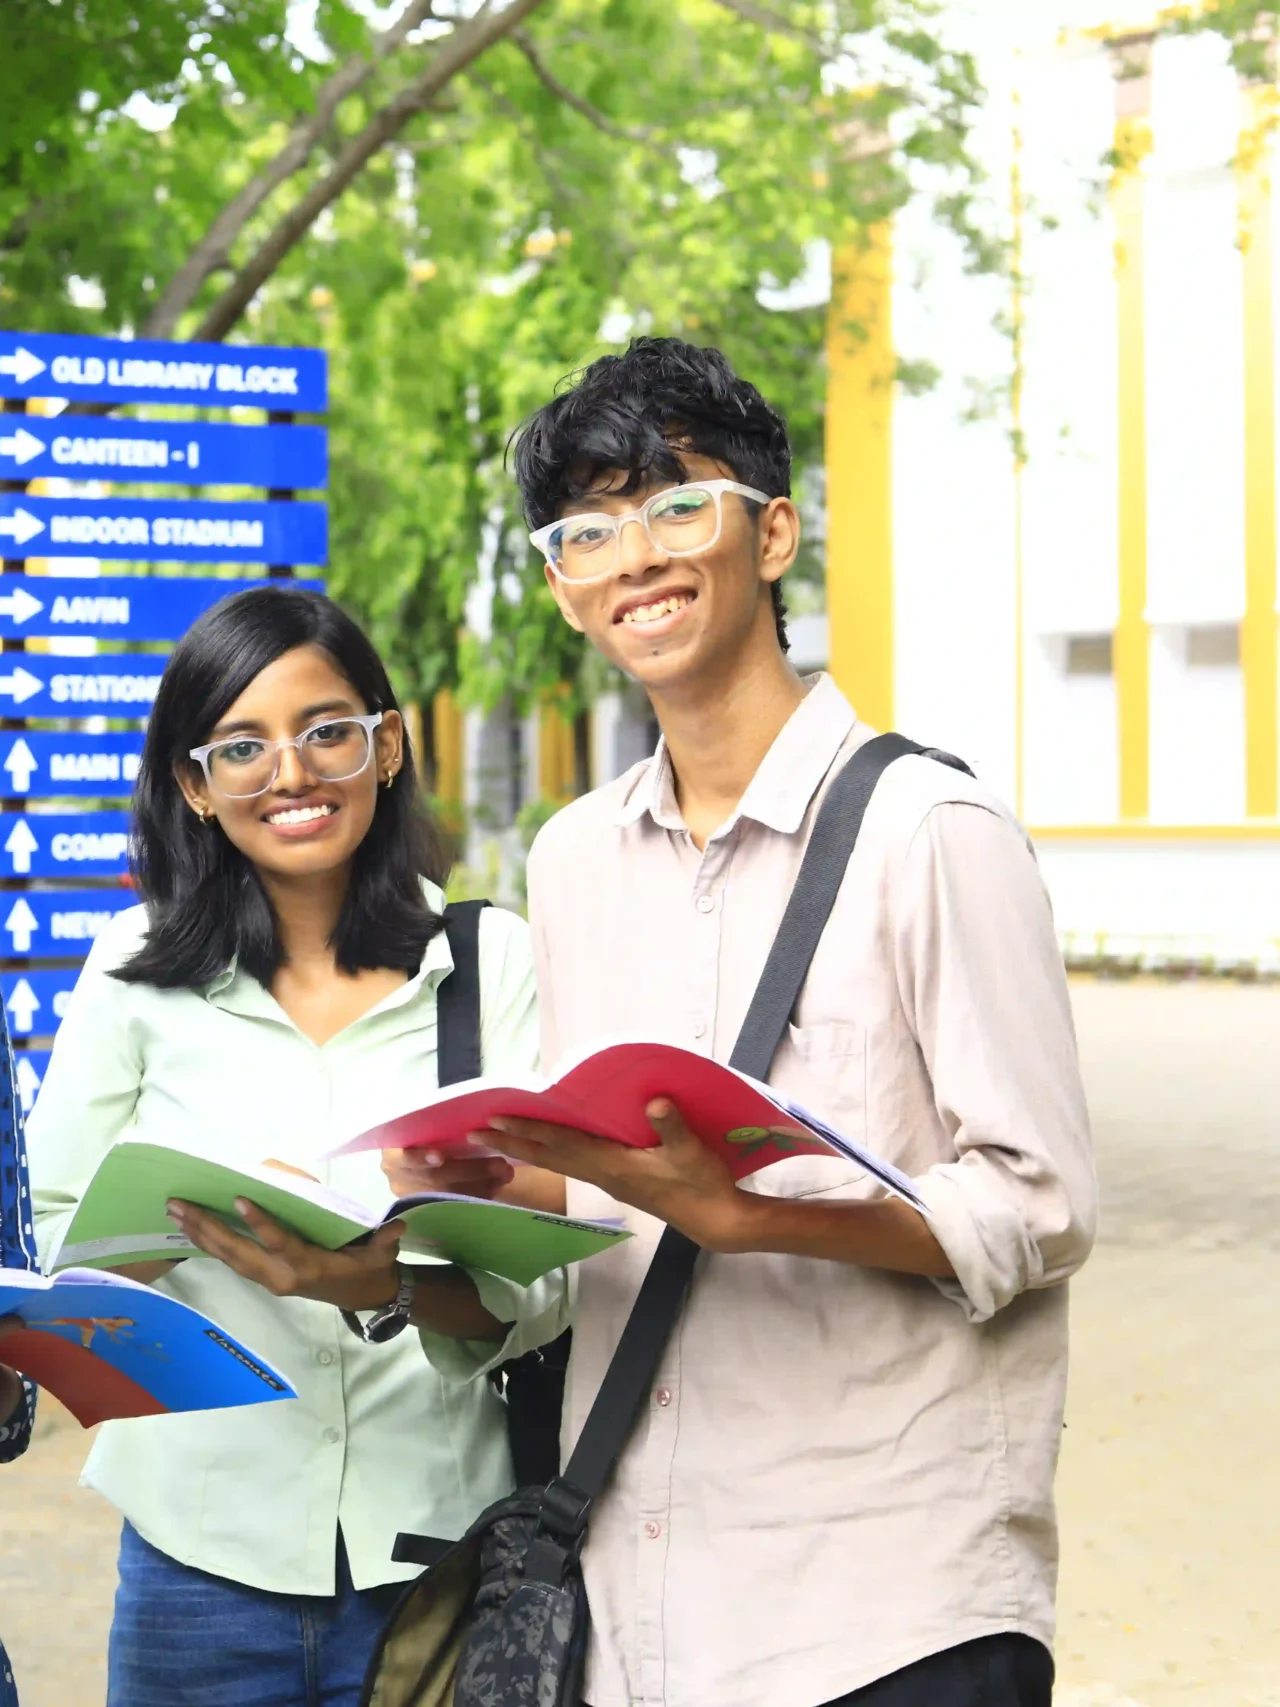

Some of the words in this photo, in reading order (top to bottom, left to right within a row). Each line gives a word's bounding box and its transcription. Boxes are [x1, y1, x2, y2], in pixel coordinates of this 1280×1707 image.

[51, 356, 106, 385] OLD
[107, 359, 214, 390] LIBRARY
[215, 364, 298, 394] BLOCK
[51, 436, 169, 467] CANTEEN
[50, 516, 150, 545] INDOOR
[151, 518, 264, 547] STADIUM
[49, 596, 130, 624] AAVIN
[50, 674, 162, 703] STATION
[50, 753, 120, 781] MAIN
[51, 833, 129, 861] COMP
